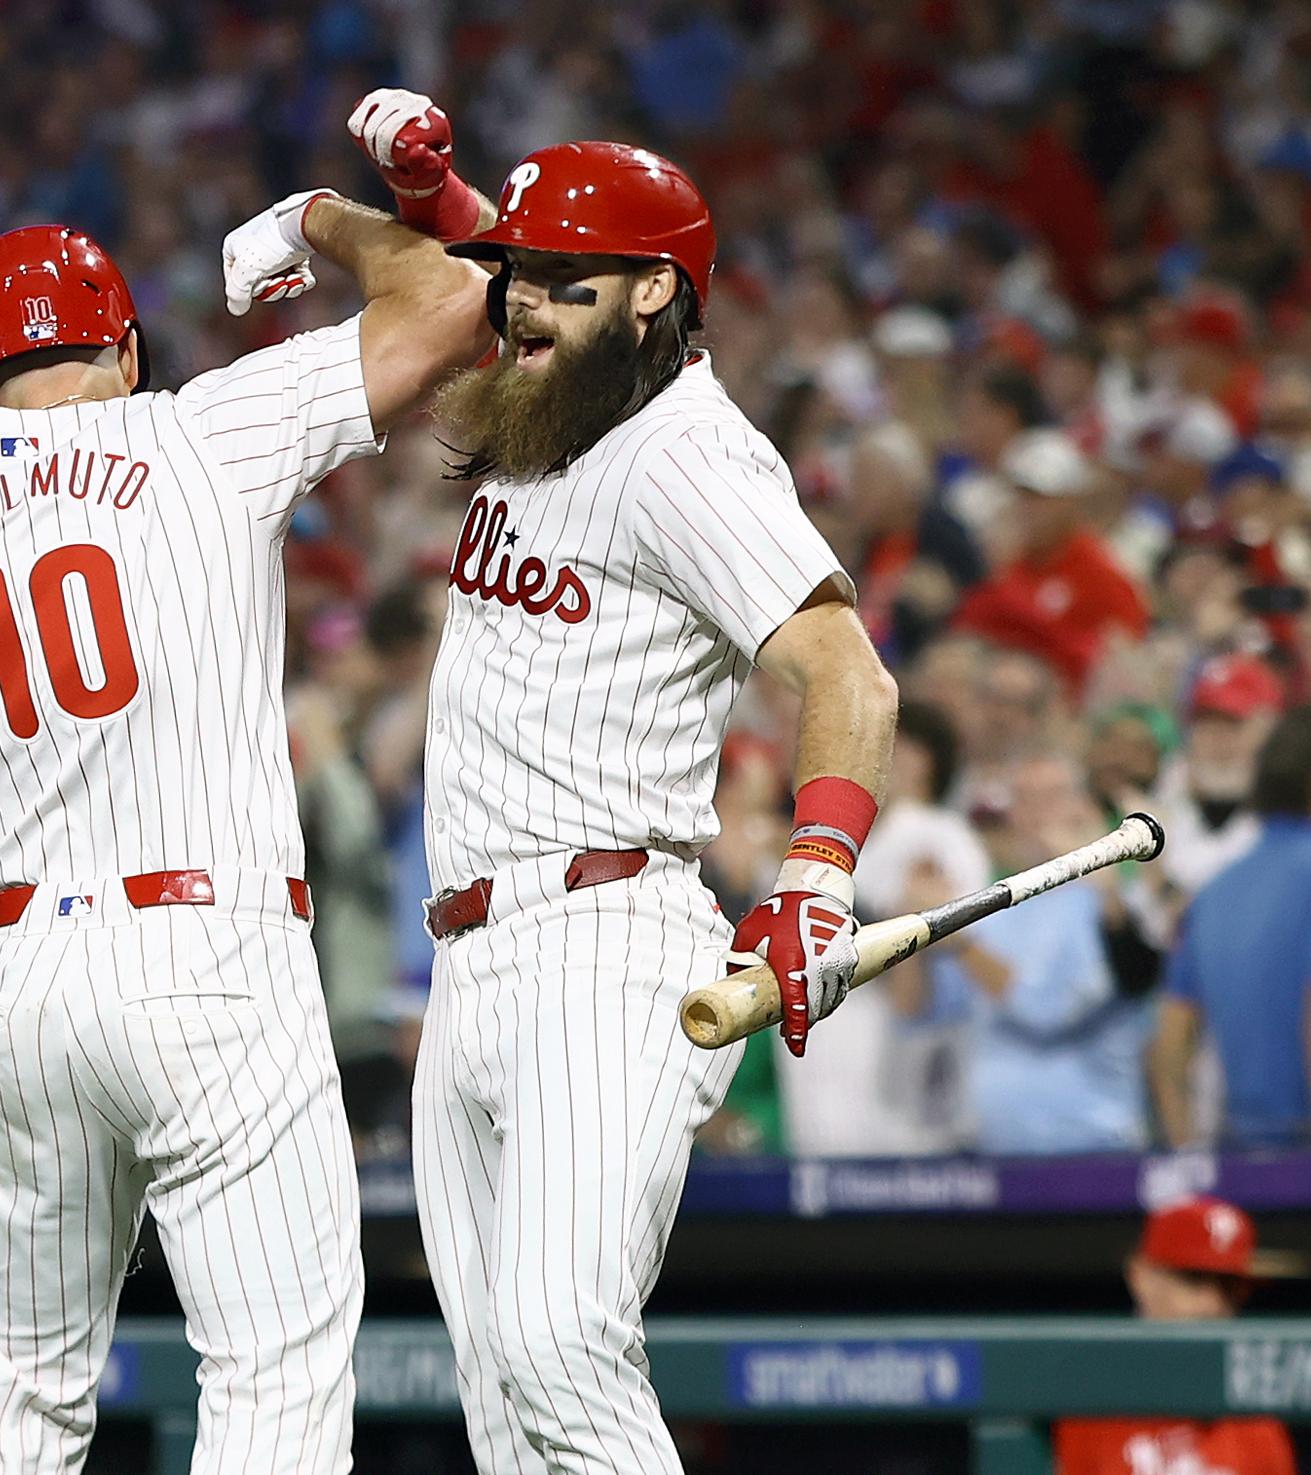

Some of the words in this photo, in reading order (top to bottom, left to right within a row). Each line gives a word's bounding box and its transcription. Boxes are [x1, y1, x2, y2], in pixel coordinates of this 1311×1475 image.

[507, 162, 541, 213] P
[24, 296, 53, 323] 10
[448, 494, 592, 625] llies
